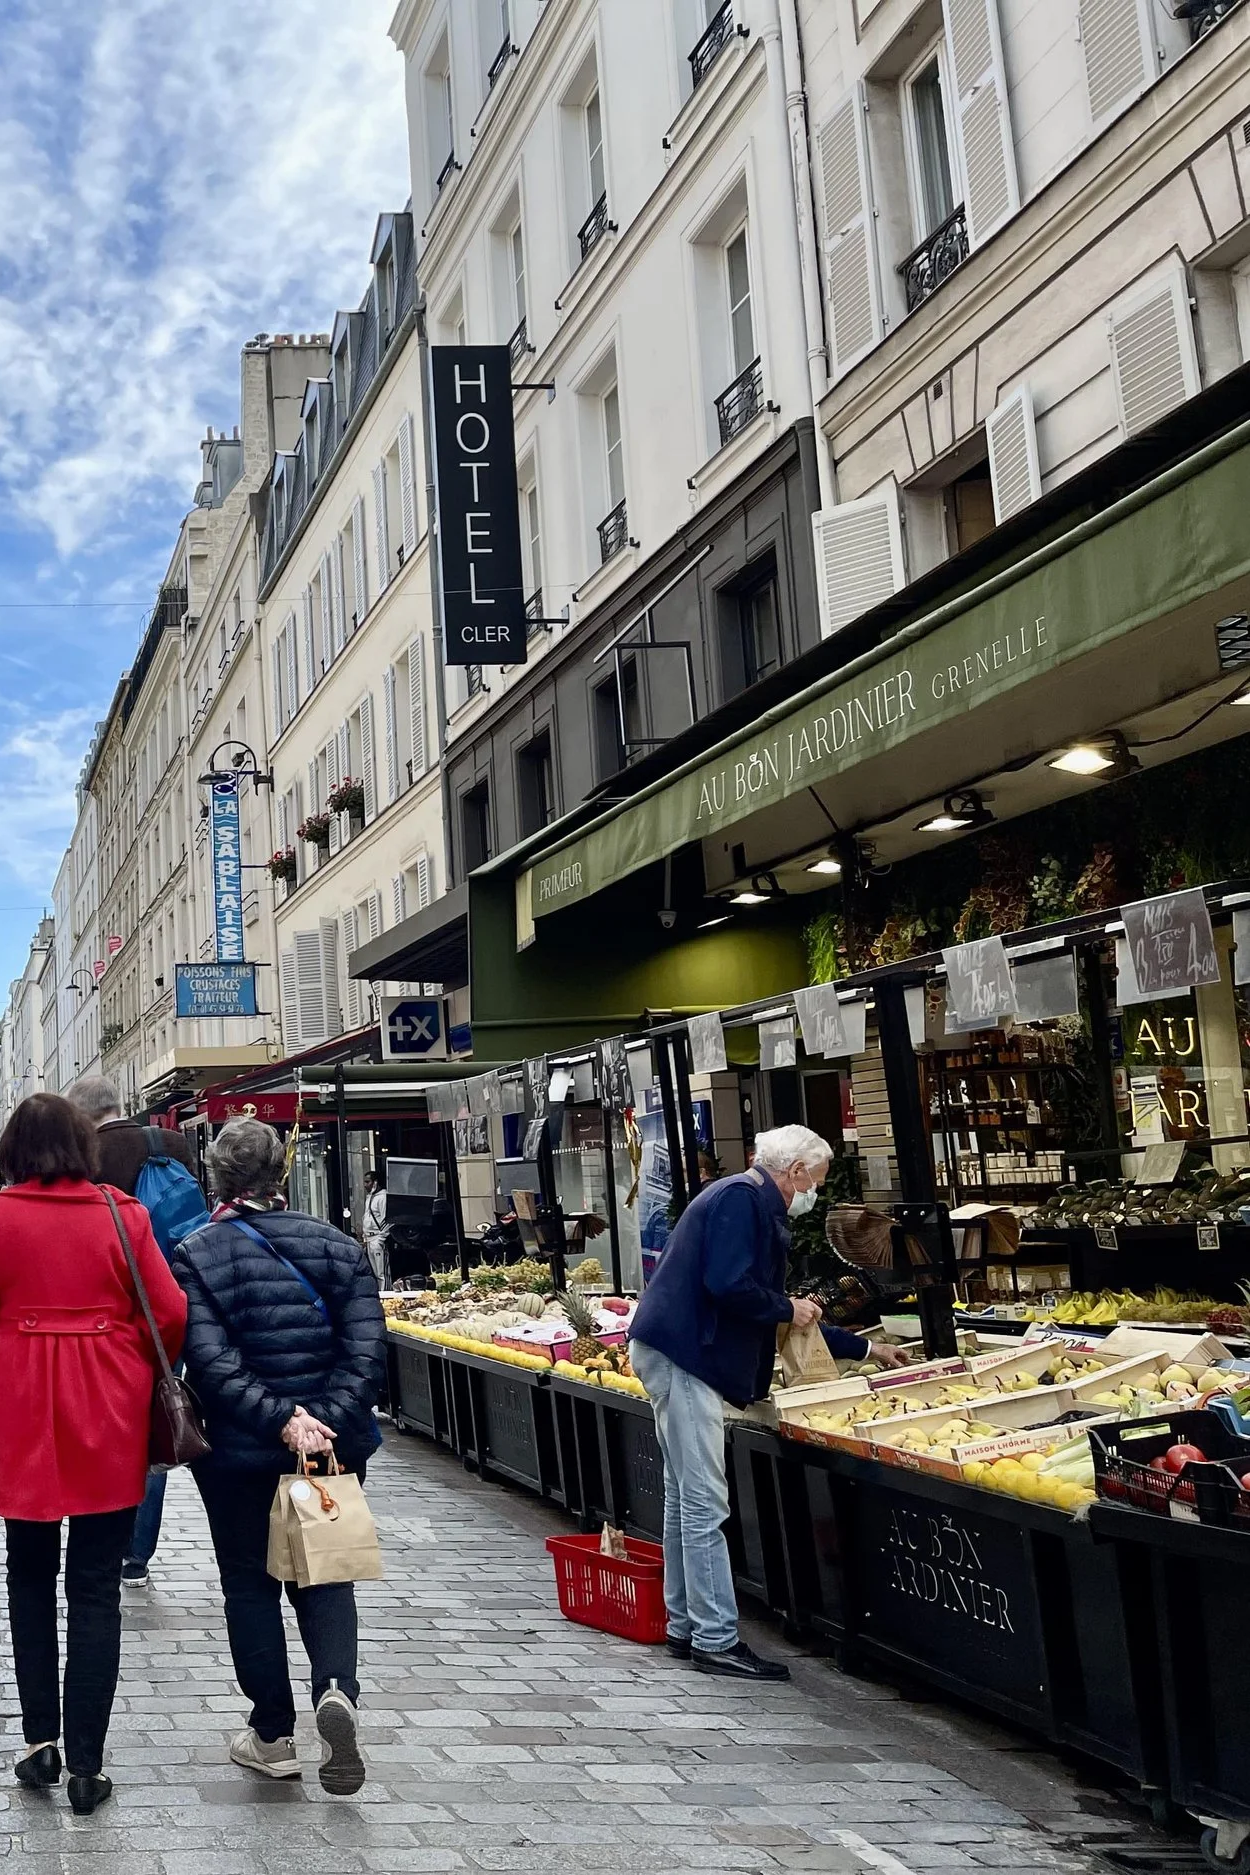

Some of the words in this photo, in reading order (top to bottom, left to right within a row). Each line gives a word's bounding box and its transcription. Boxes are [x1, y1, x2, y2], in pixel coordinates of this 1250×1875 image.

[454, 363, 496, 605] HOTEL
[461, 625, 511, 643] CLER
[696, 771, 727, 820] AU
[735, 742, 780, 793] BON
[788, 669, 917, 781] JARDINIER
[931, 616, 1048, 699] GRENELLE
[214, 800, 238, 815] LA
[216, 826, 240, 960] SABLAISE
[539, 861, 583, 902] PRIMEUR
[177, 966, 226, 978] POISSONS
[231, 966, 252, 978] FINS
[191, 991, 239, 1004] TRAITEUR
[1130, 1017, 1195, 1056] AU
[964, 1446, 996, 1457] MAISON
